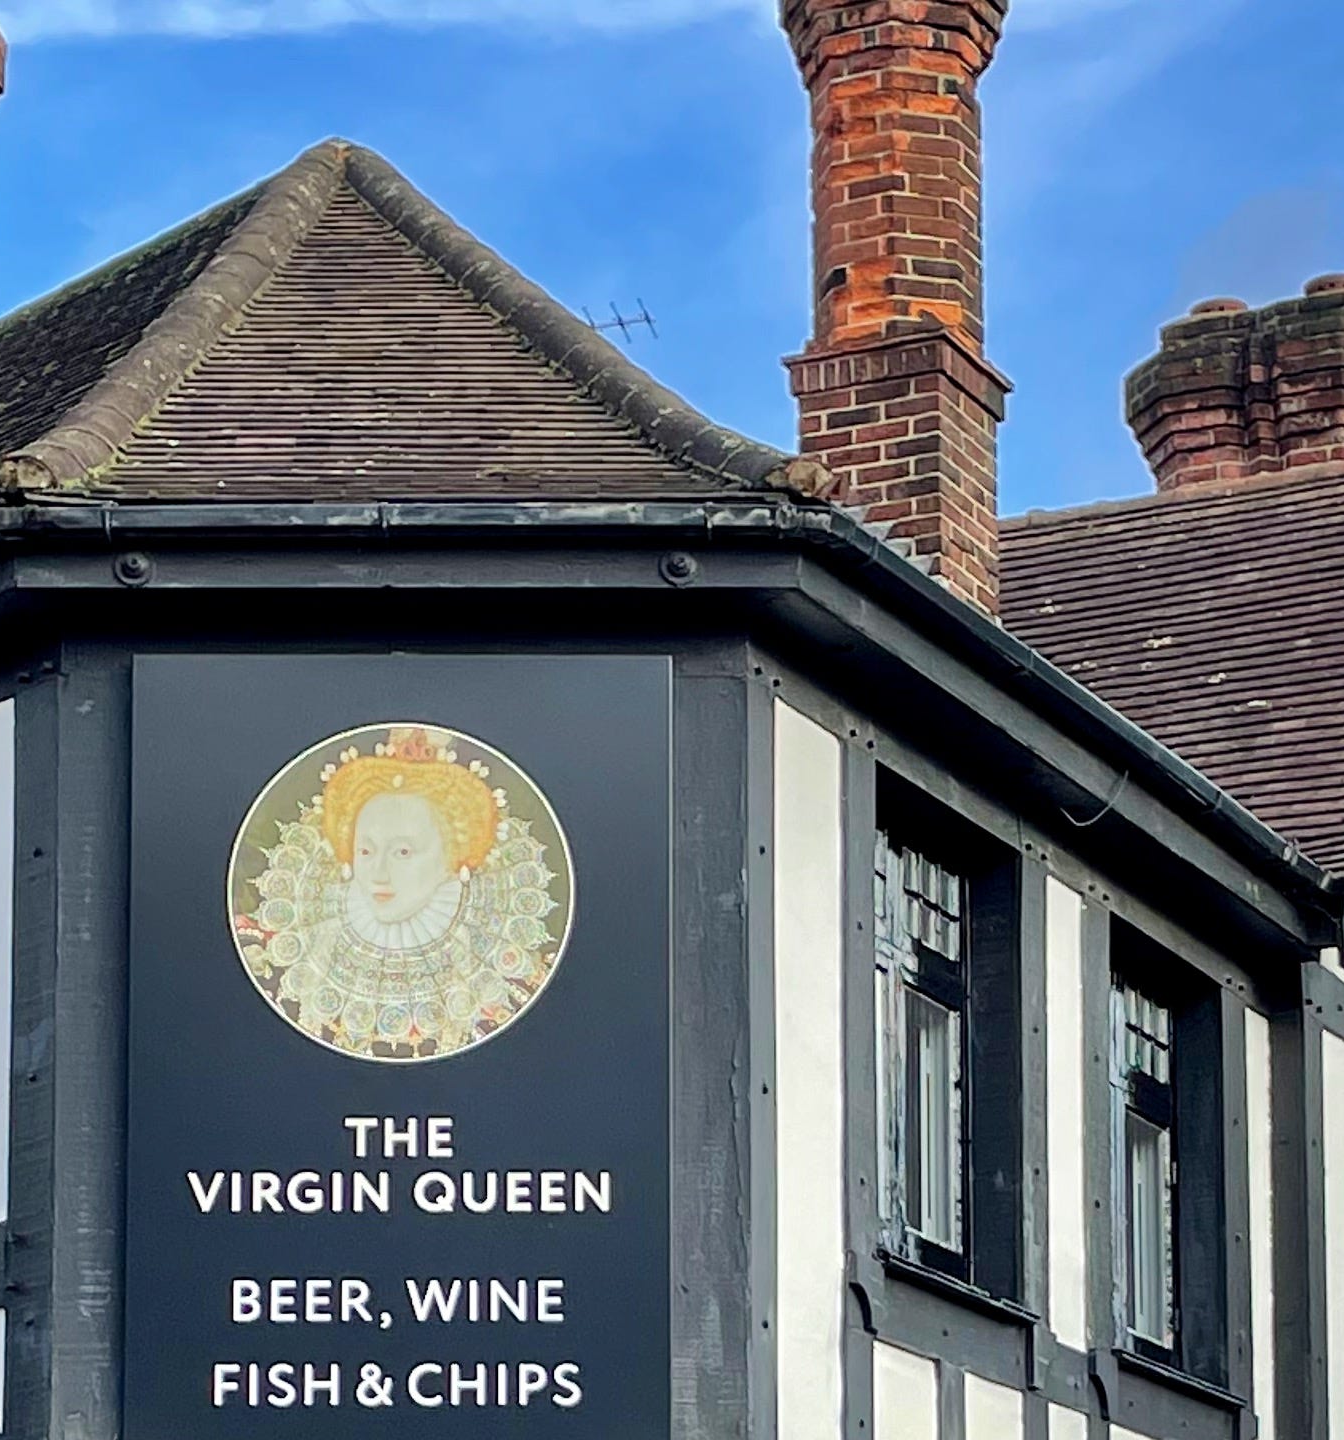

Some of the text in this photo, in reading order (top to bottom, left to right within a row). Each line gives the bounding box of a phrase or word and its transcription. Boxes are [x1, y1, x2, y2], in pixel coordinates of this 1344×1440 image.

[344, 1117, 455, 1158] THE
[187, 1171, 611, 1213] VIRGIN QUEEN
[231, 1279, 565, 1330] BEER, WINE
[212, 1363, 583, 1407] FISH & CHIPS
